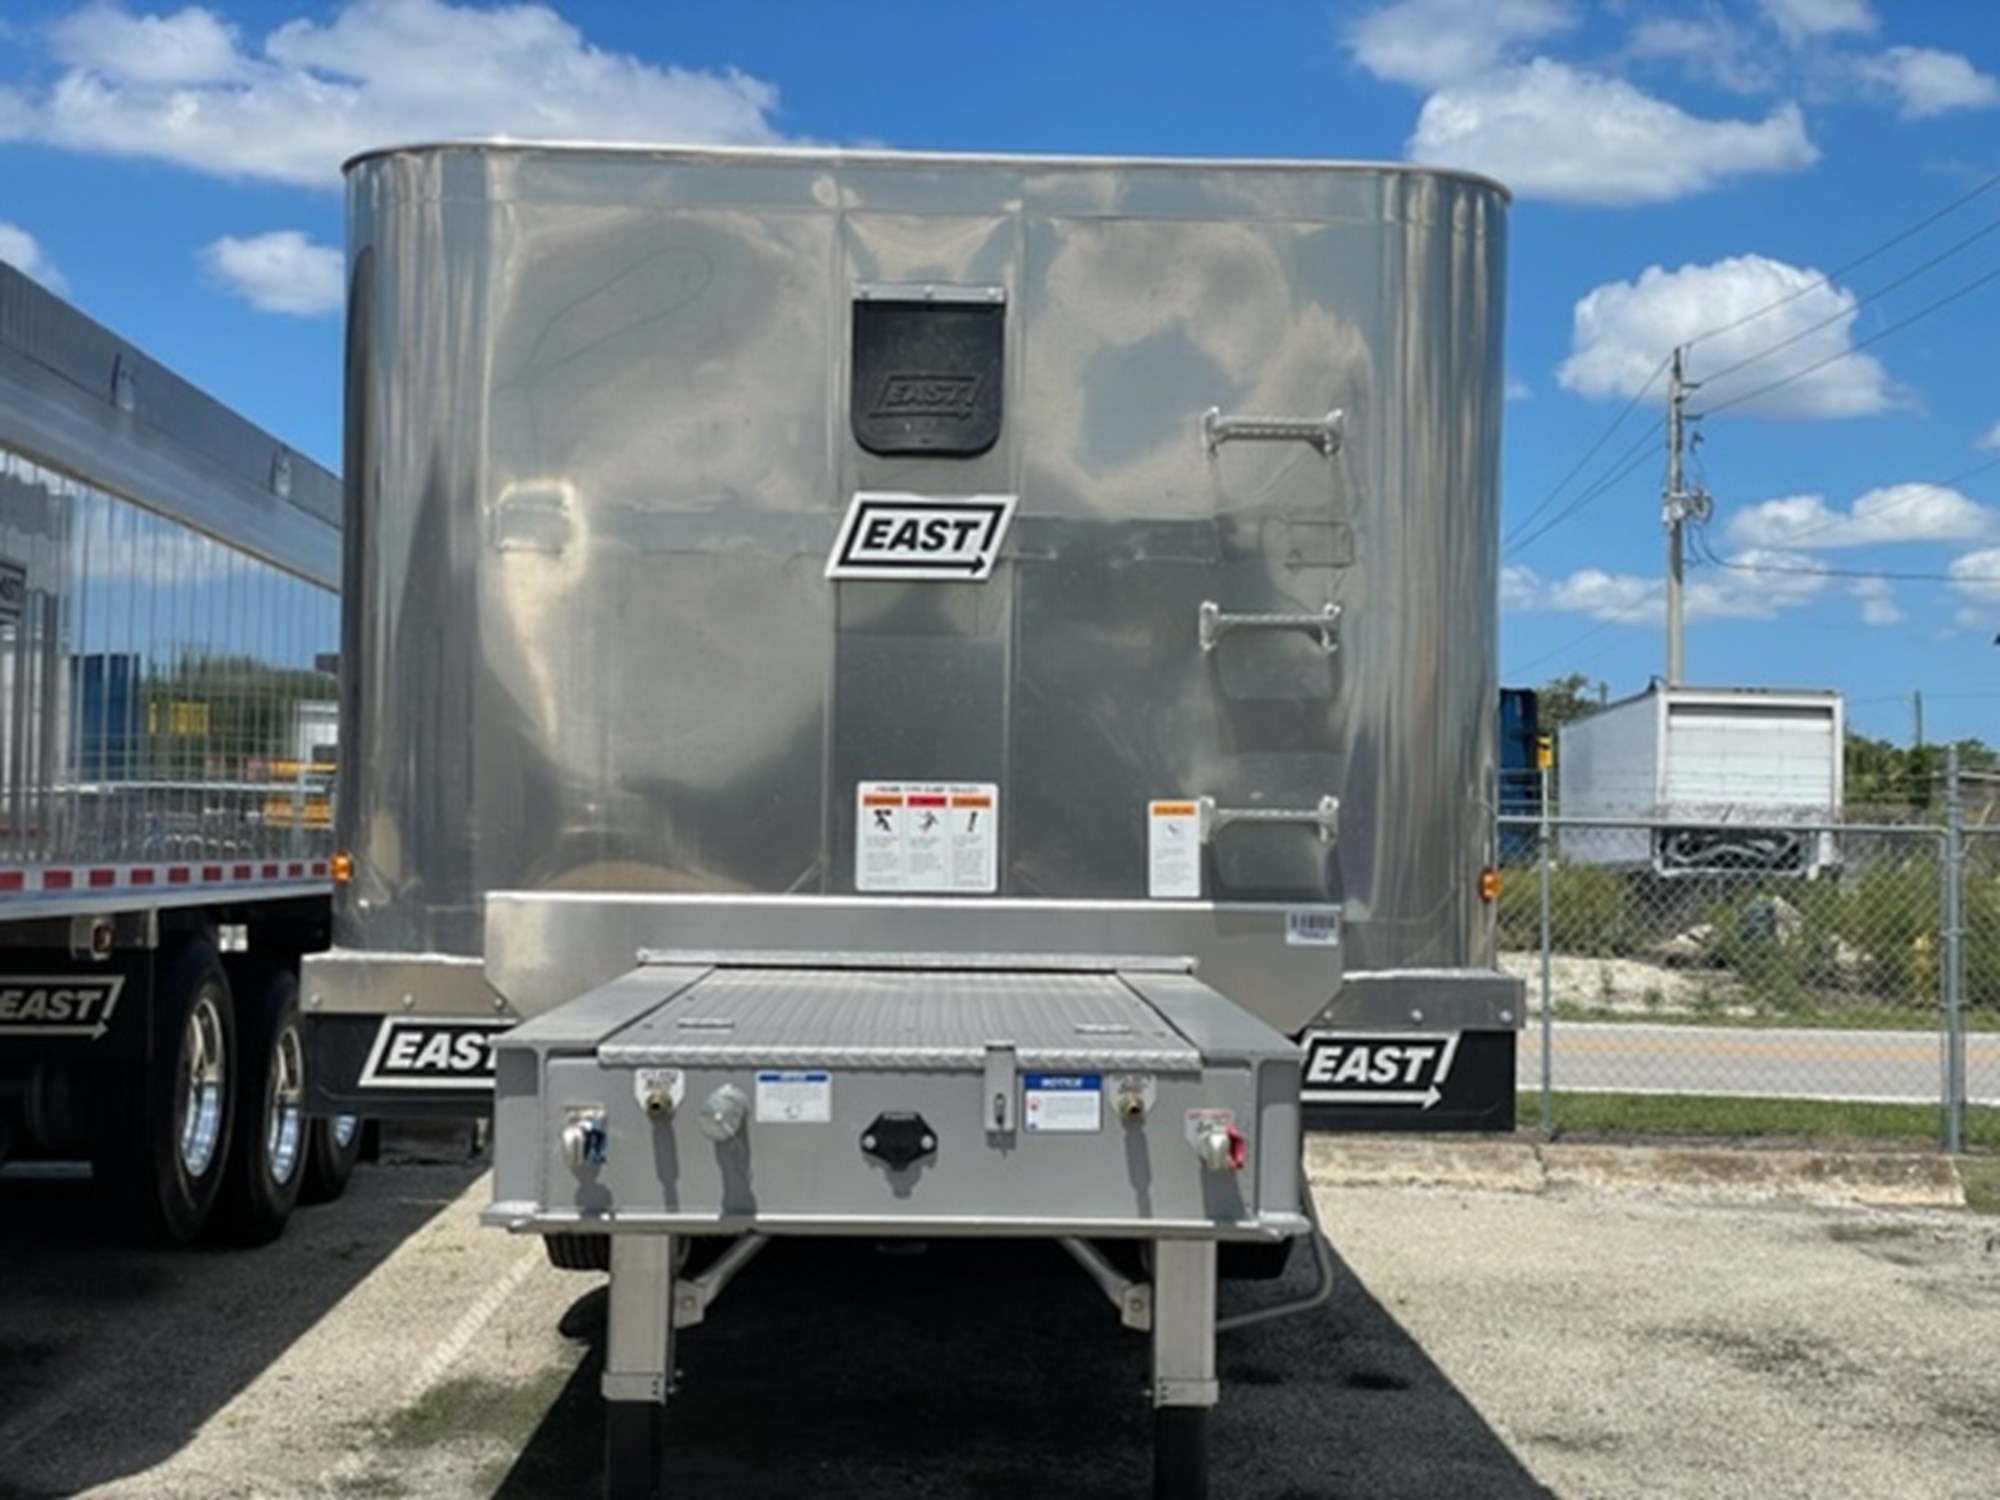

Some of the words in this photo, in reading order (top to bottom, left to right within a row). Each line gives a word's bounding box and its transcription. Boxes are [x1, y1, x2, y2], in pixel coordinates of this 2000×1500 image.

[886, 383, 967, 406] EAST
[862, 519, 981, 552] EAST
[0, 990, 103, 1020] EAST
[1306, 1046, 1435, 1083] EAST
